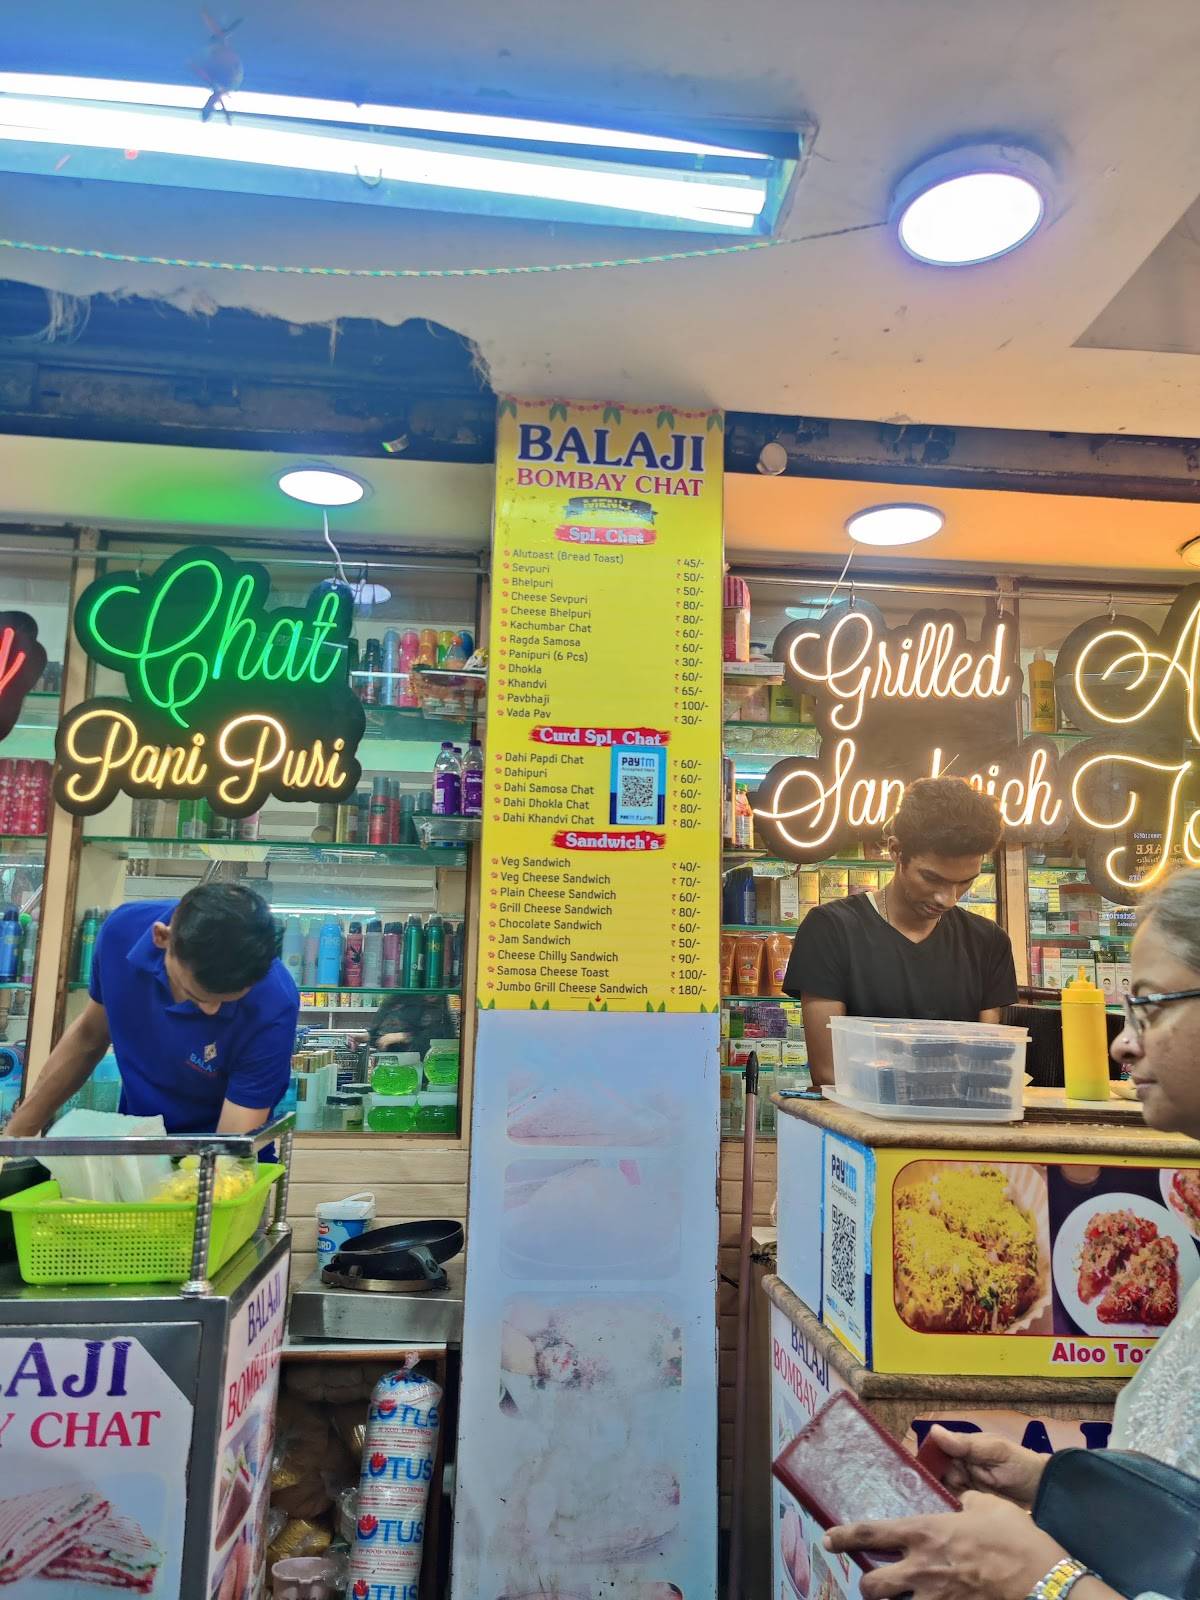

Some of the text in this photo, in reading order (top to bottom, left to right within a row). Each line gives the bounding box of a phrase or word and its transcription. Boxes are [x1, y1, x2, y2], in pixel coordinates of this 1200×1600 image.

[518, 424, 704, 472] BALAJI
[517, 468, 704, 497] BOMBAY CHAT
[569, 528, 644, 544] Spl. Chat
[513, 549, 624, 564] Alutoast (Bread Toast)
[512, 563, 550, 573] Sevpuri
[512, 578, 553, 588] Bhelpuri
[511, 592, 588, 605] Cheese Sevpuri
[511, 606, 591, 619] Cheese Bhelpuri
[511, 621, 592, 633] Kachumbar Chat
[89, 560, 342, 728] Chat
[509, 635, 580, 646] Ragda Samosa
[509, 650, 588, 662] Panipuri (6 Pcs)
[509, 664, 542, 674] Dhokla
[790, 612, 1011, 731] Grilled
[508, 678, 547, 688] Khandvi
[507, 693, 550, 706] Pavbhaji
[507, 708, 551, 718] Vada Pav
[540, 728, 662, 746] Curd Spl. Chat
[66, 709, 347, 804] Pani Puri
[506, 753, 584, 765] Dahi Papdi Chat
[505, 768, 547, 778] Dahipuri
[504, 783, 594, 795] Dahi Samosa Chat
[753, 737, 1063, 848] Sanich
[504, 798, 589, 810] Dahi Dhokla Chat
[503, 813, 594, 824] Dahi Khandvi Chat
[566, 833, 660, 849] Sandwich's
[502, 856, 570, 868] Veg Sandwich
[501, 872, 610, 885] Veg Cheese Sandwich
[500, 887, 616, 900] Plain Cheese Sandwich
[500, 903, 612, 915] Grill Cheese Sandwich
[499, 918, 602, 930] Chocolate Sandwich
[498, 935, 570, 945] Jam Sandwich
[498, 950, 618, 963] Cheese Chilly Sandwich
[497, 966, 609, 977] Samosa Cheese Toast
[496, 982, 648, 994] Jumbo Grill Cheese Sandwich
[248, 1270, 281, 1347] BALAJI
[791, 1320, 830, 1393] BALAJI
[1052, 1342, 1106, 1363] Aloo
[0, 1341, 132, 1398] AJI
[773, 1337, 818, 1418] BOMBAY
[226, 1340, 269, 1430] BOMBAY
[30, 1411, 162, 1448] CHAT
[356, 1516, 424, 1542] OTUS
